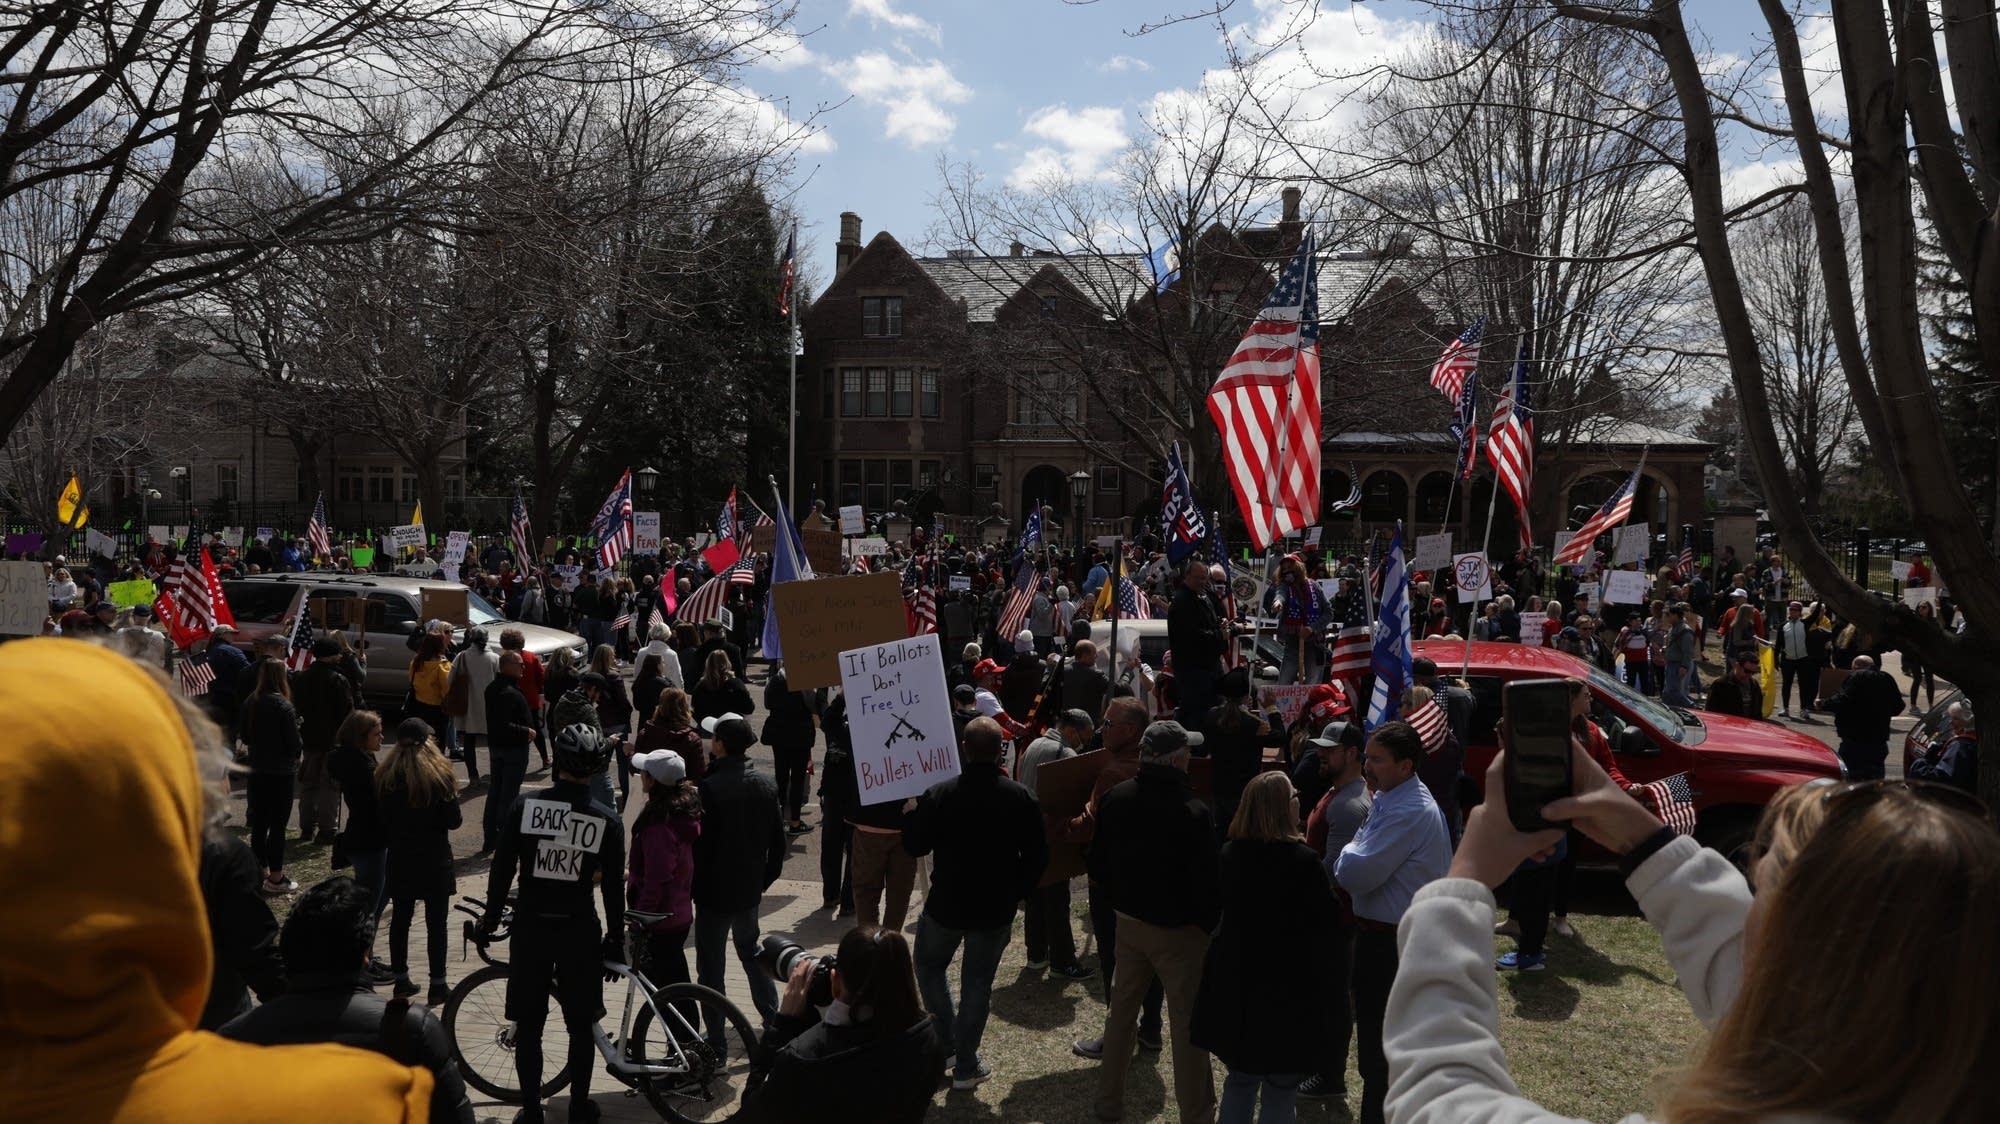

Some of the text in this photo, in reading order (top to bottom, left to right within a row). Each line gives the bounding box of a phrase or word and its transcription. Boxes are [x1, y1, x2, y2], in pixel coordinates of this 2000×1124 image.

[635, 515, 658, 527] FACTS
[636, 535, 658, 549] FEAR
[845, 653, 867, 677] If
[878, 643, 932, 669] Ballots
[872, 672, 902, 692] Don't
[861, 690, 921, 716] Free Us
[861, 746, 952, 791] Bullets Will!
[531, 806, 570, 832] BACK
[570, 818, 597, 848] TO
[537, 848, 582, 877] WORK
